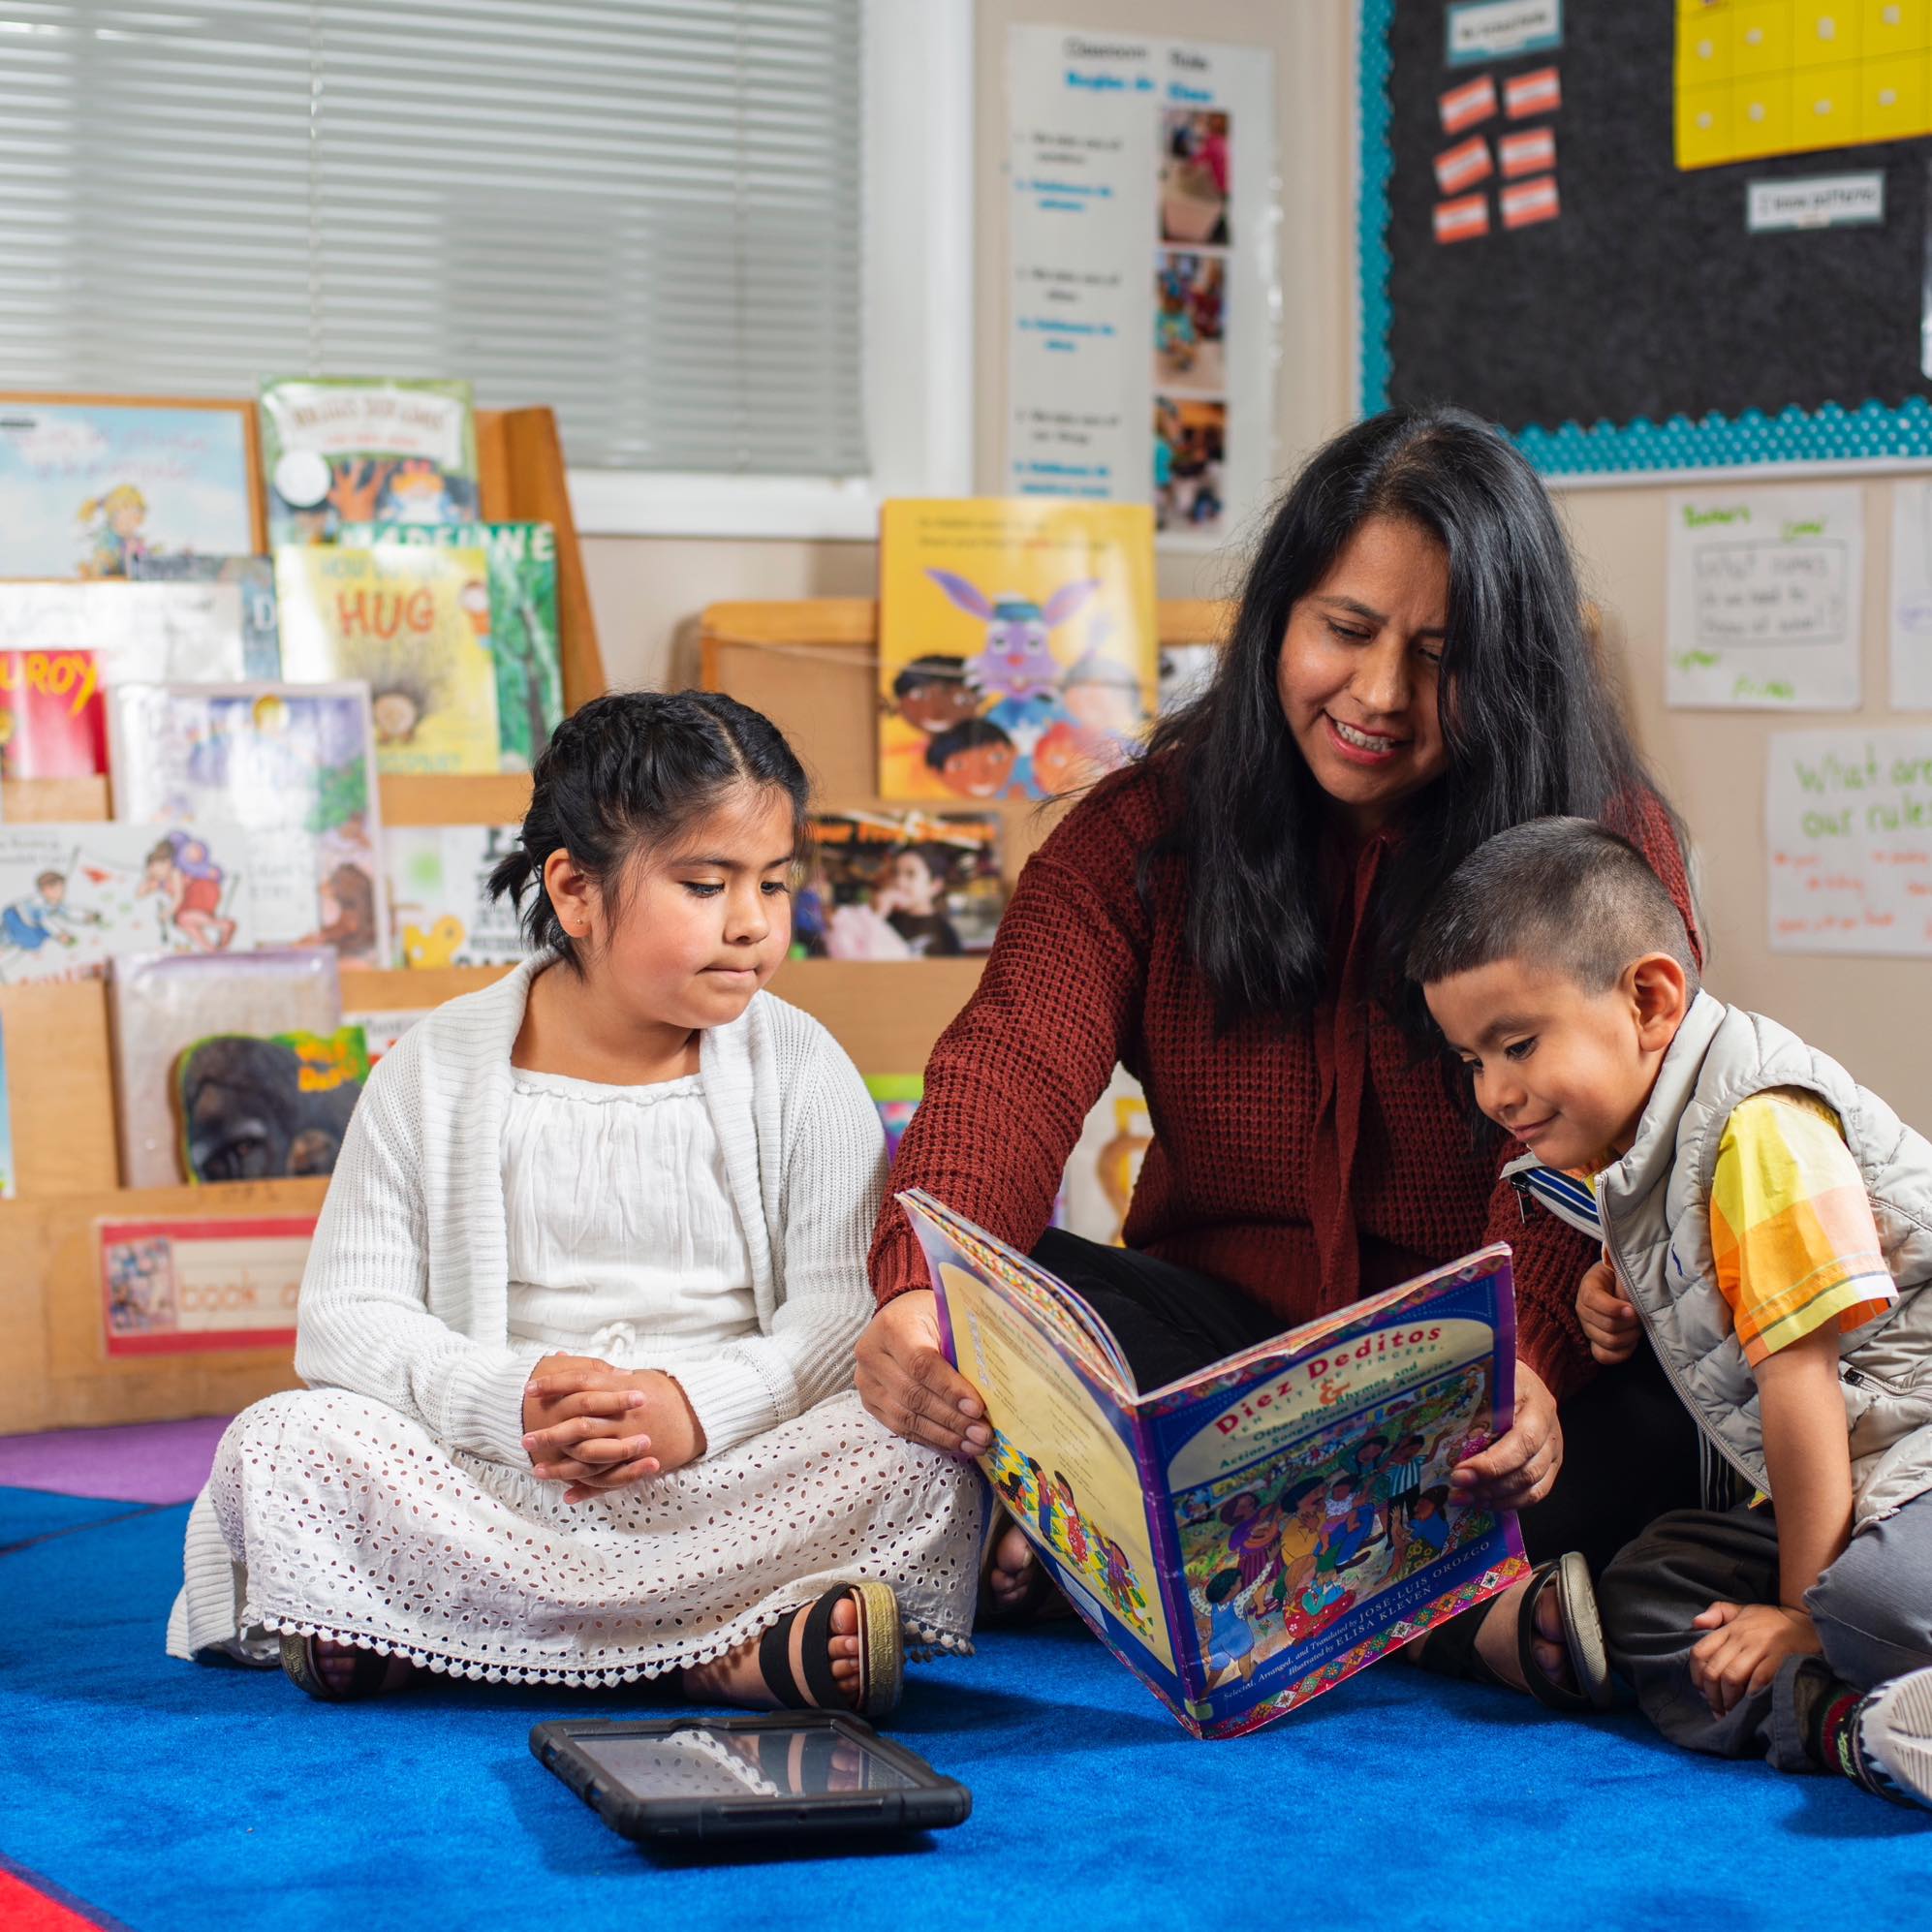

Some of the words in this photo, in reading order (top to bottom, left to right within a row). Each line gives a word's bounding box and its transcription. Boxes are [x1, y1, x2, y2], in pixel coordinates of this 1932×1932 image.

[335, 587, 435, 640] HUG
[1215, 1381, 1293, 1435] Diez
[1307, 1327, 1441, 1380] Deditos
[1220, 1445, 1266, 1469] Action
[1271, 1424, 1311, 1446] Songs
[1396, 1359, 1452, 1388] America
[1253, 1420, 1293, 1442] Other
[1336, 1378, 1387, 1405] Rhymes
[1393, 1360, 1418, 1379] and
[1319, 1378, 1351, 1406] &
[1289, 1649, 1325, 1676] Illustrated
[1336, 1621, 1375, 1647] ELISA
[1380, 1585, 1432, 1621] KLEVEN
[1310, 1623, 1349, 1650] Translated
[1432, 1542, 1490, 1578] OROZCO
